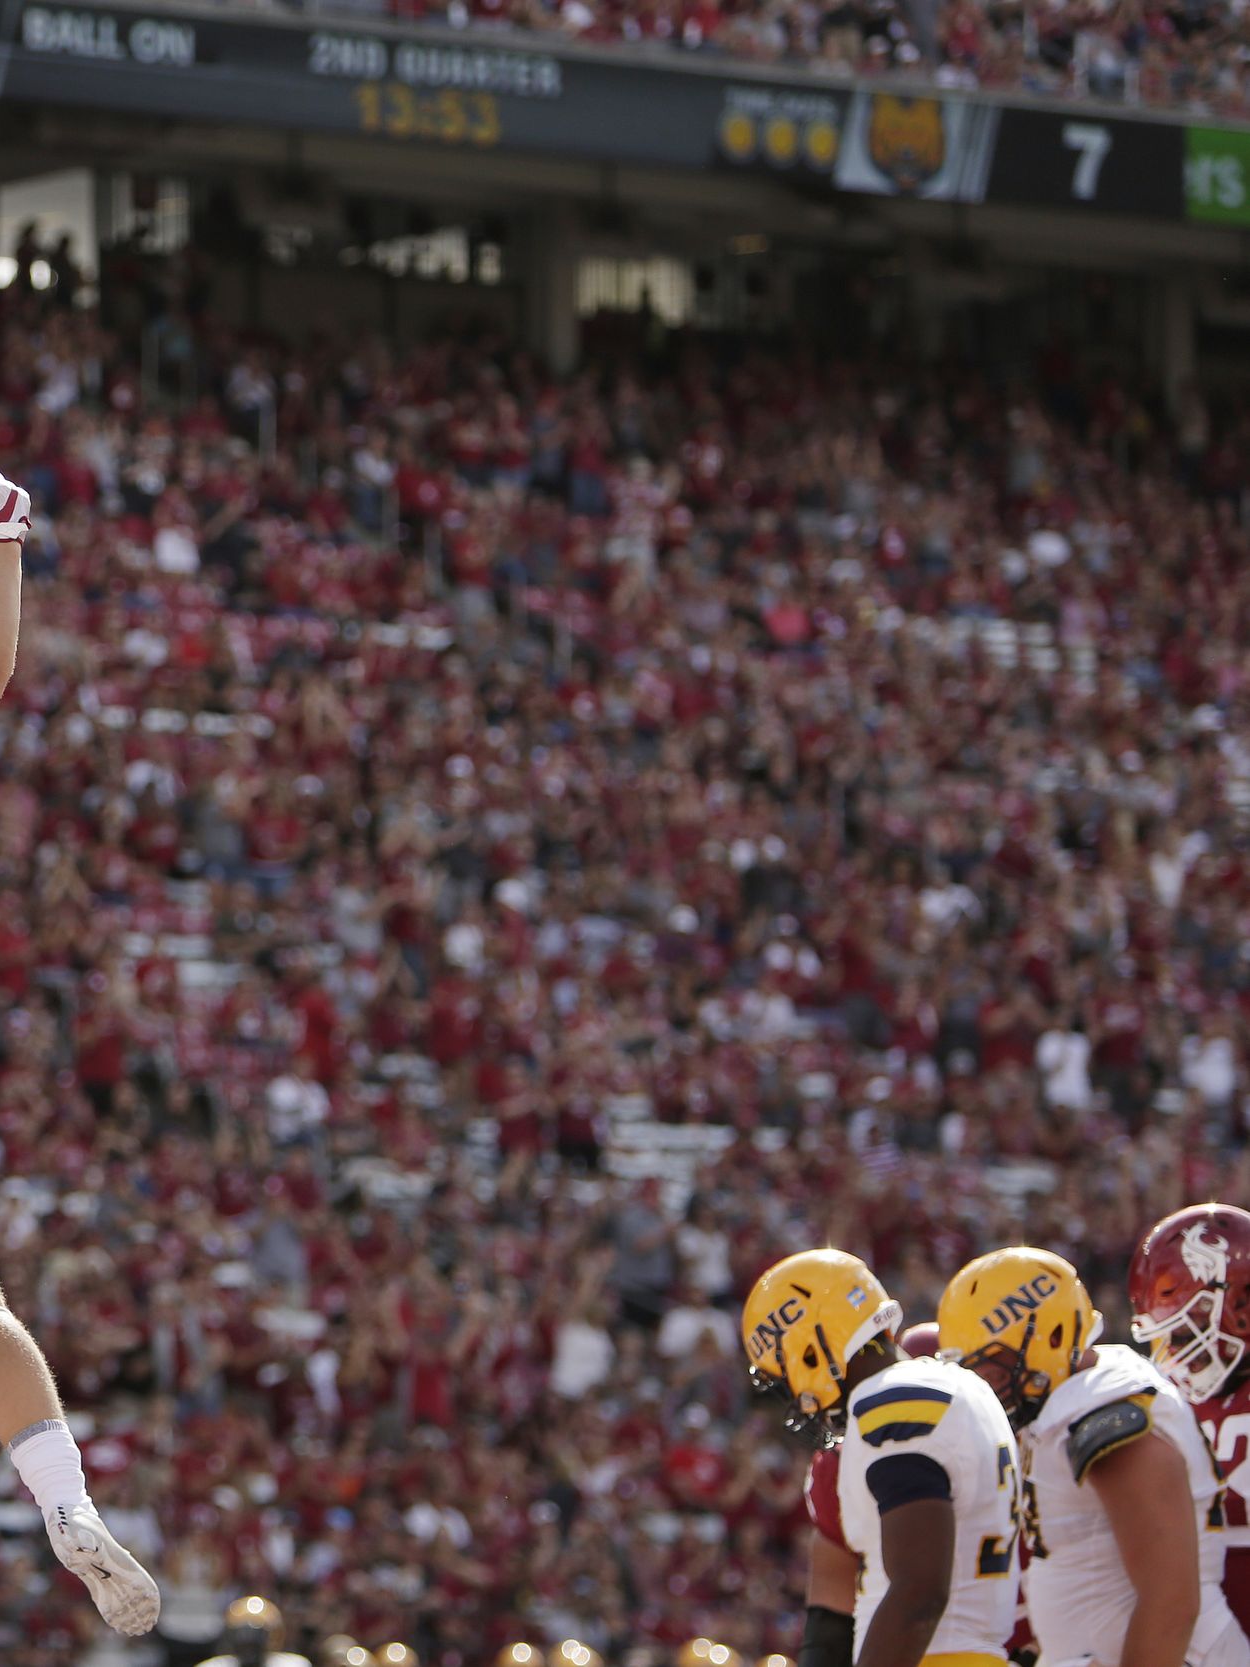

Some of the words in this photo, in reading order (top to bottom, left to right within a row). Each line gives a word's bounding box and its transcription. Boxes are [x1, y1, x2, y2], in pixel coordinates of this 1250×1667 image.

[22, 7, 126, 61] BALL
[129, 18, 197, 67] ON
[309, 36, 388, 78] 2ND
[395, 43, 563, 97] QUARTER
[1062, 123, 1111, 200] 7
[751, 1298, 805, 1360] UNC
[981, 1274, 1056, 1334] UNC
